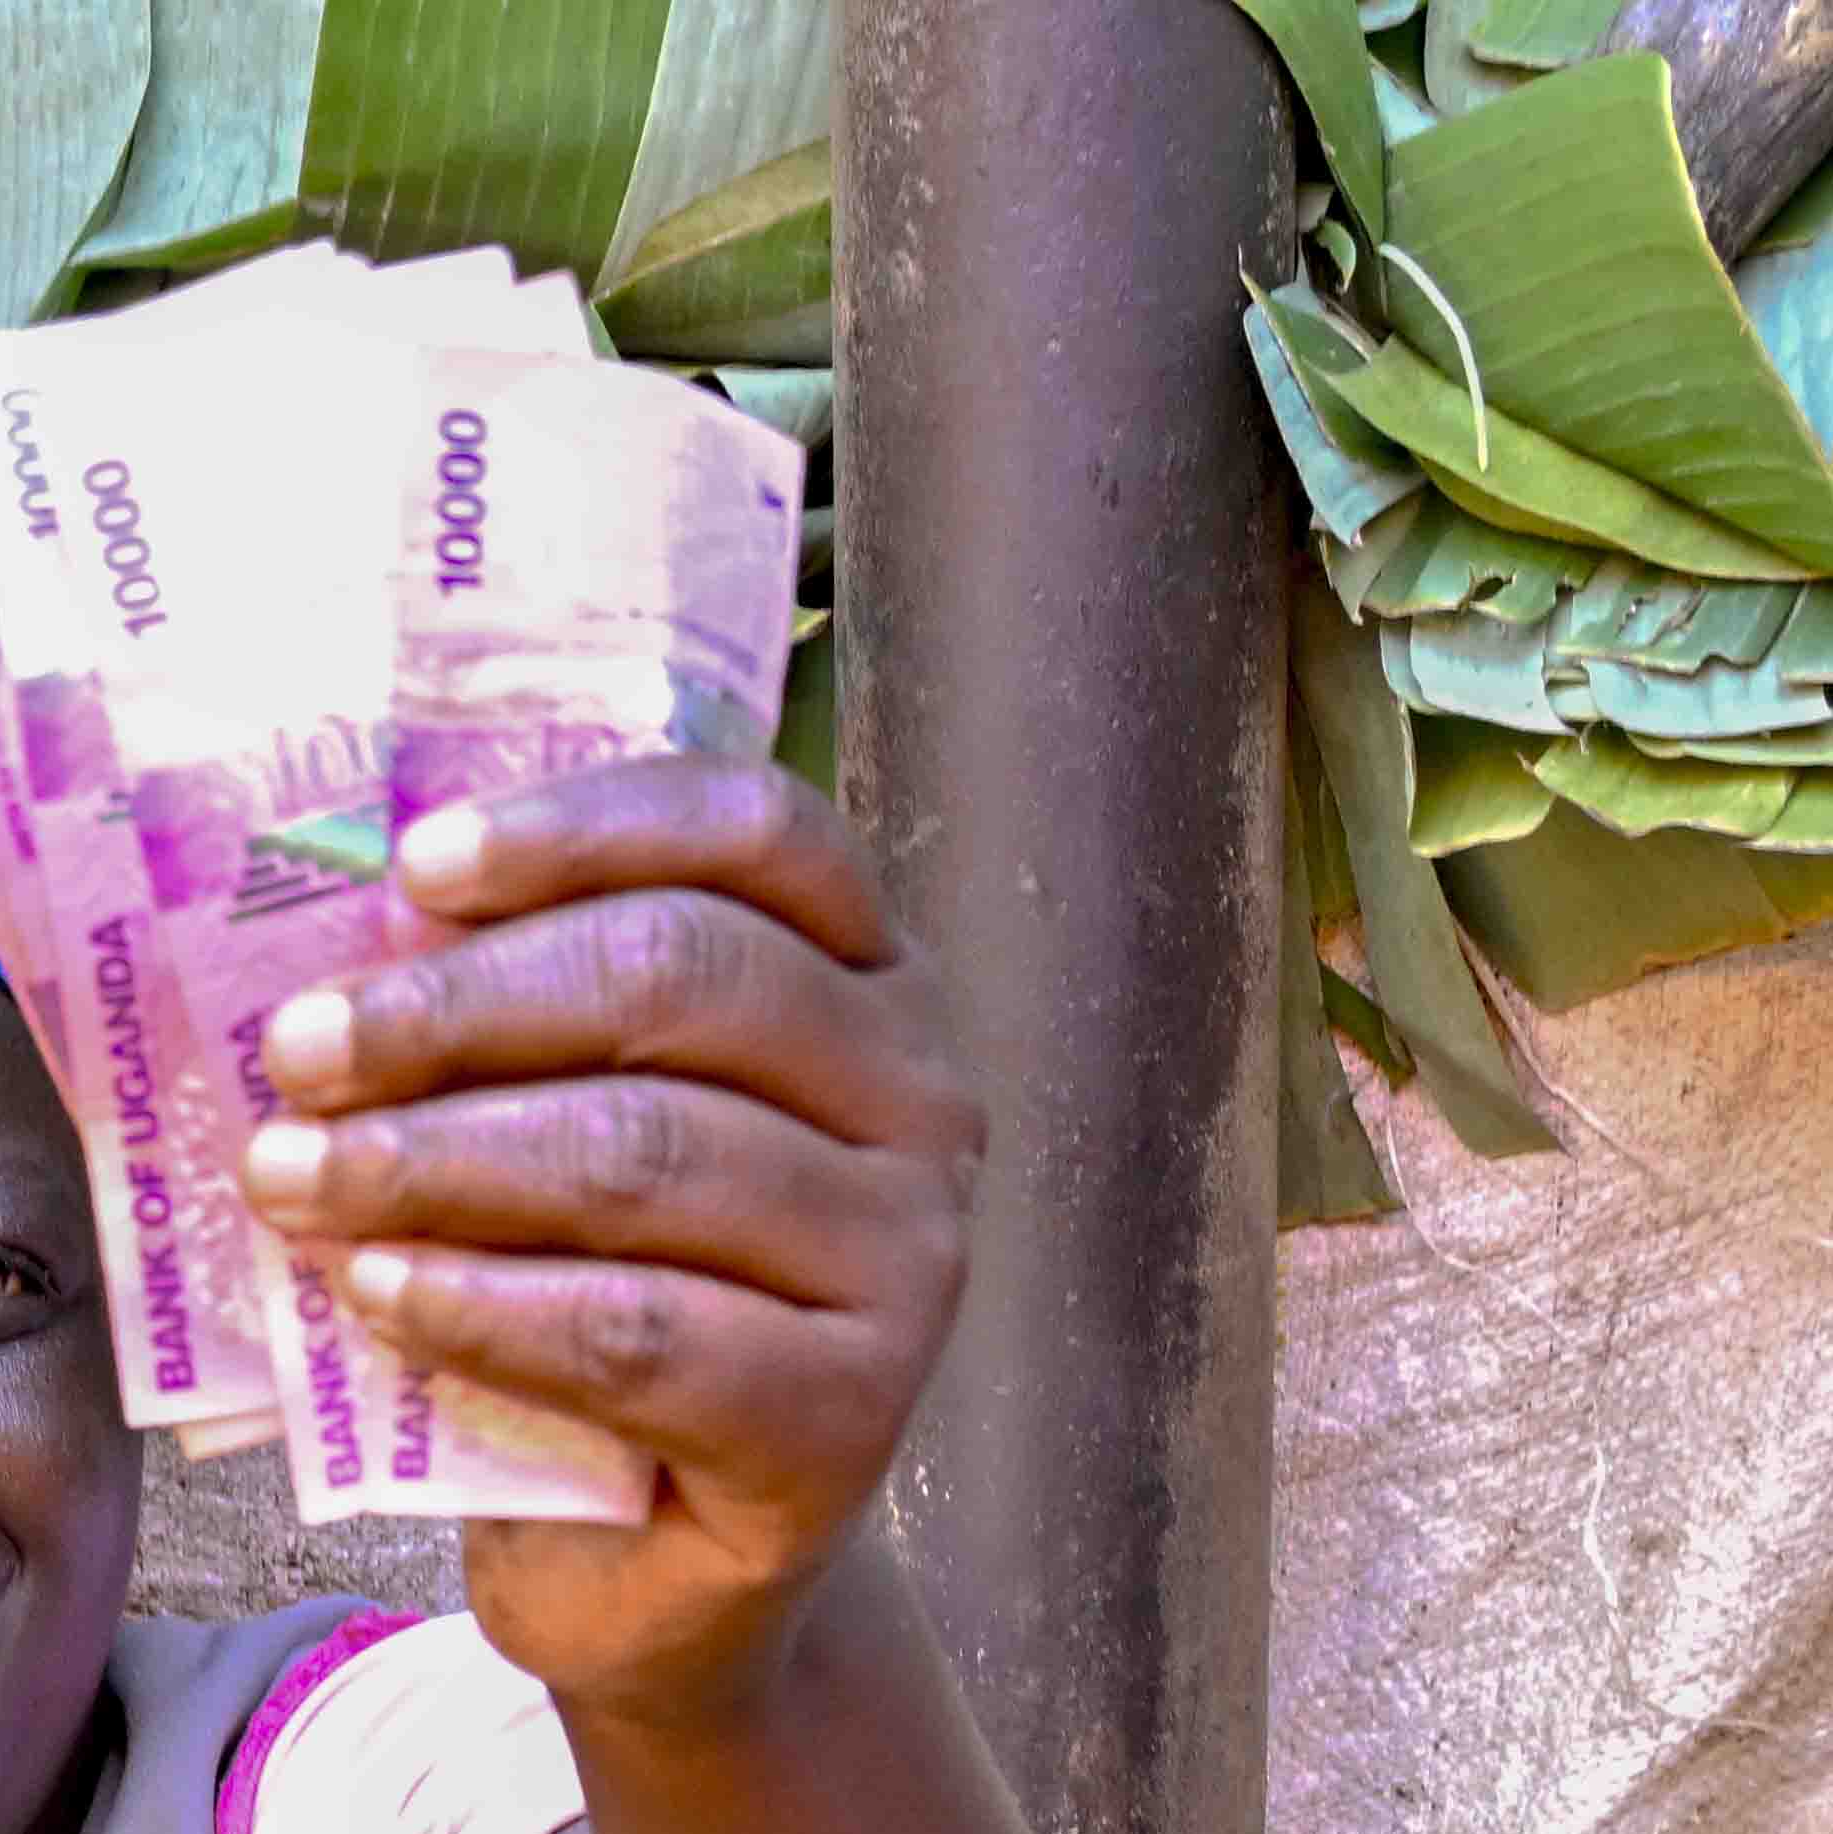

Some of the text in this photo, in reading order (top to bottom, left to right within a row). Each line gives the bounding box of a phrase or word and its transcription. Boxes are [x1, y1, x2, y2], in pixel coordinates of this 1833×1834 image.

[82, 458, 168, 638] 10000
[437, 408, 488, 598] 10000
[89, 915, 197, 1394] BANK OF UGANDA
[305, 1336, 363, 1489] BANK
[392, 1367, 432, 1481] BAN
